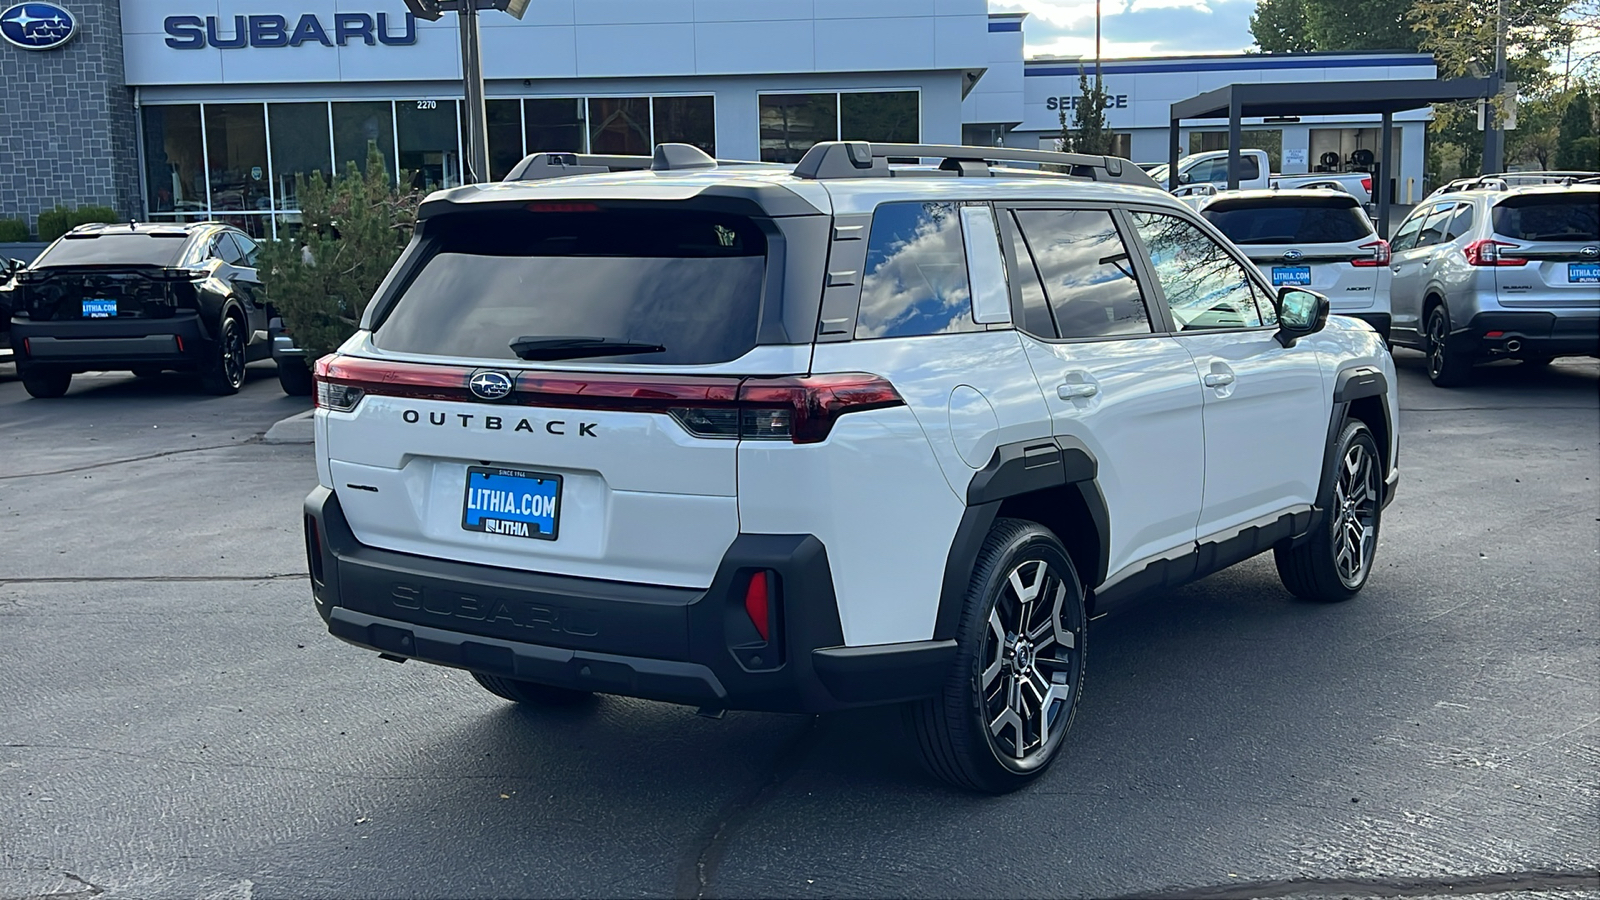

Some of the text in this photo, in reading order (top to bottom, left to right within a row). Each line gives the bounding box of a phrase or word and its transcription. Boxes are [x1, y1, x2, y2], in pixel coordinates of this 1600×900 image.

[164, 12, 417, 50] SUBARU
[416, 100, 437, 109] 2270
[1273, 271, 1310, 280] LITHIA.COM
[83, 304, 117, 312] LITHIA.COM
[402, 409, 598, 437] OUTBACK
[498, 469, 514, 477] SINCE
[467, 487, 556, 518] LITHIA.COM
[495, 519, 529, 537] LITHIA
[391, 582, 599, 637] SUBARU
